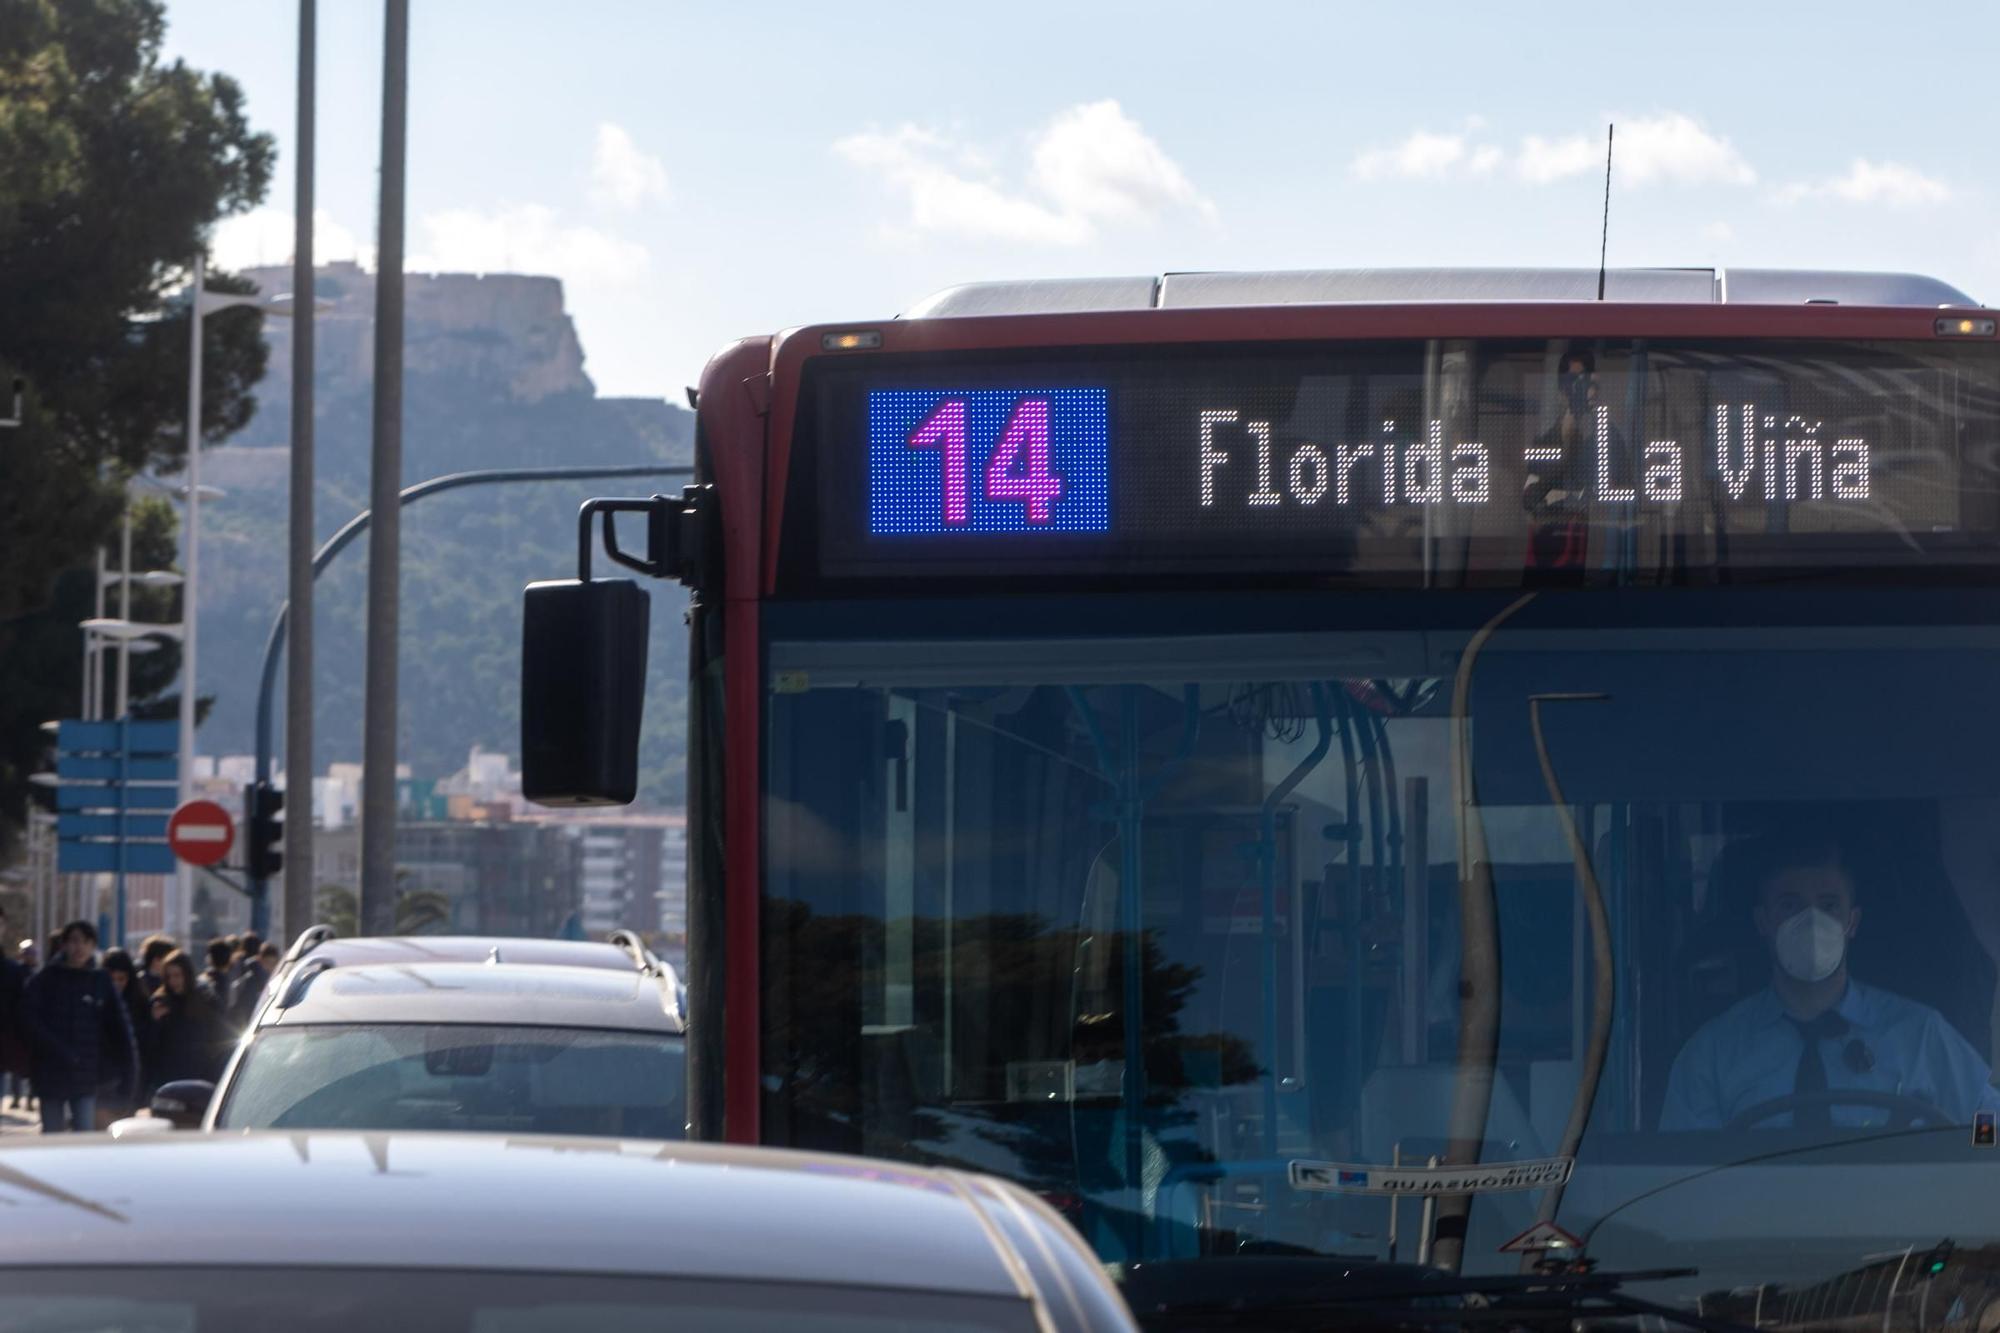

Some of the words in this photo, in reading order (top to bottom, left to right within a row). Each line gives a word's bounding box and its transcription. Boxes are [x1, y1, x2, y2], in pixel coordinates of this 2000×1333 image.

[908, 400, 1062, 523] 14
[1200, 410, 1490, 507] Florida
[1523, 447, 1563, 461] -
[1595, 405, 1684, 502] La
[1716, 403, 1871, 501] Viña
